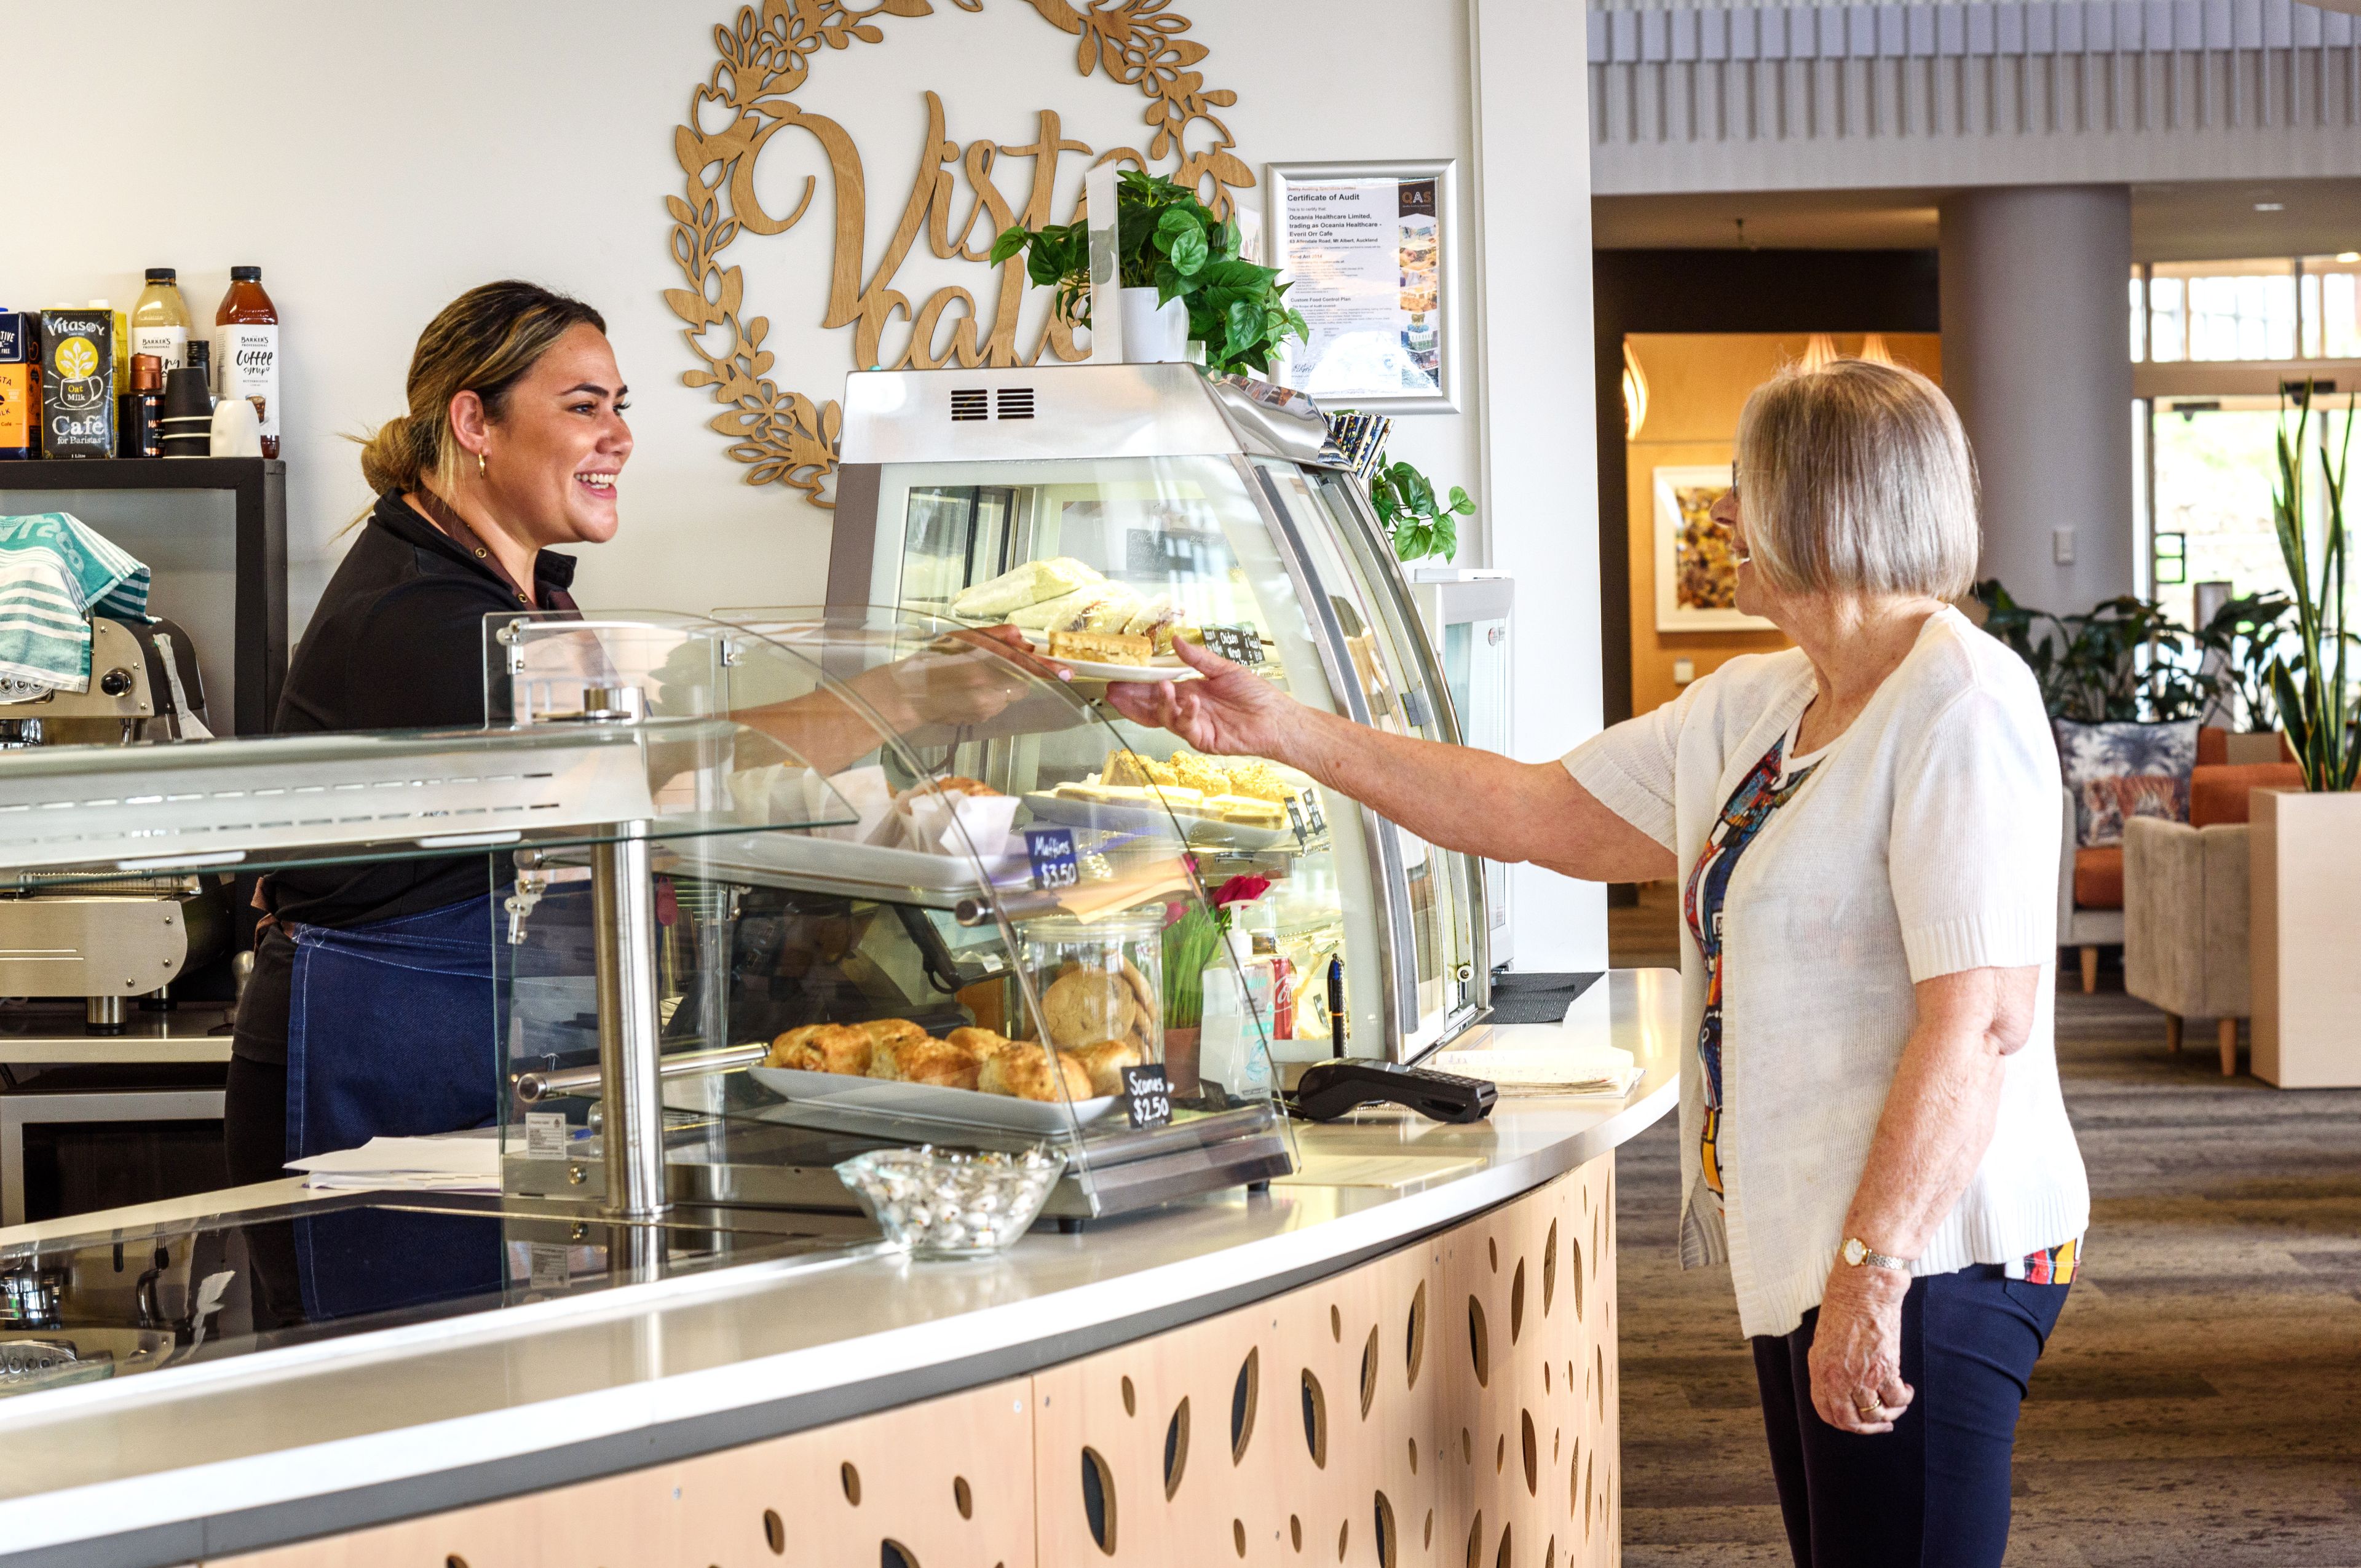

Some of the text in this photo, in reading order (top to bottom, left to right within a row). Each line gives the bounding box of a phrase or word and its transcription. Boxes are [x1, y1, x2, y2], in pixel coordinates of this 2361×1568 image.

[1402, 191, 1432, 204] QAS
[236, 350, 273, 366] Coffee
[52, 414, 105, 436] Café
[70, 436, 101, 445] Baristas
